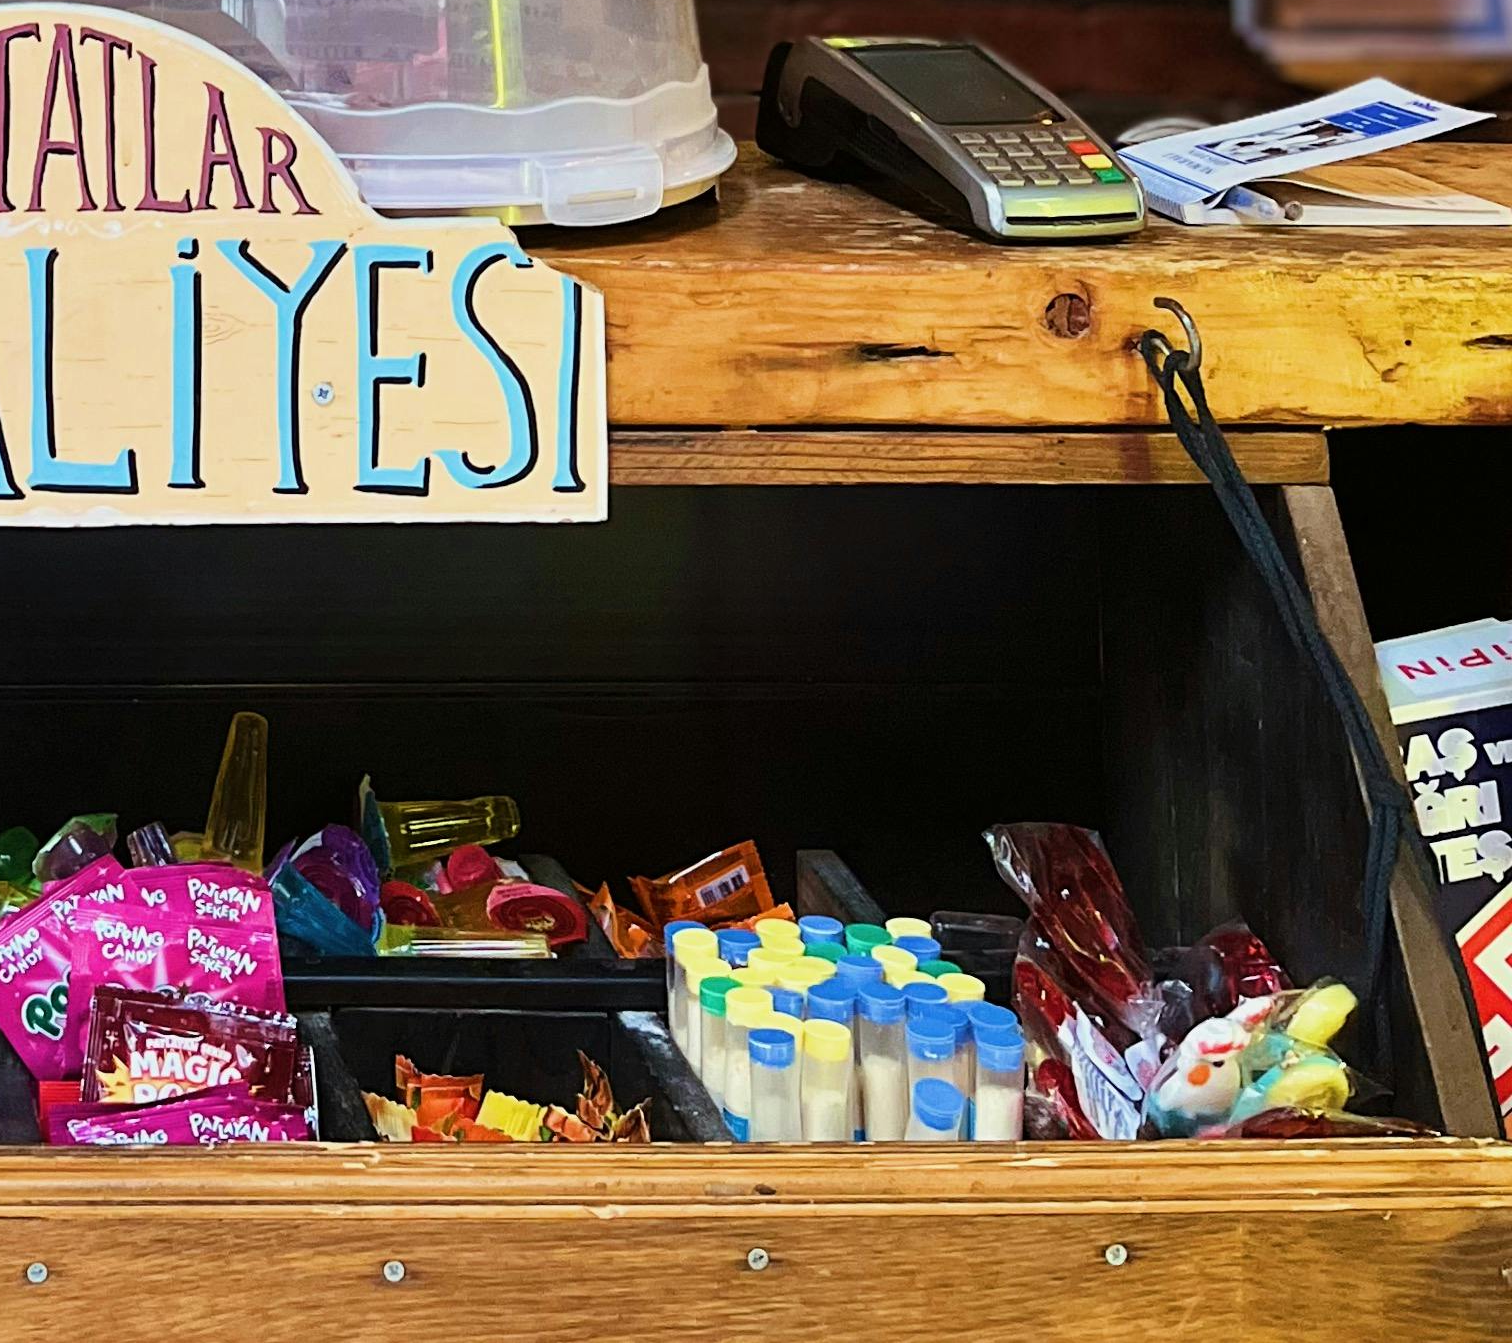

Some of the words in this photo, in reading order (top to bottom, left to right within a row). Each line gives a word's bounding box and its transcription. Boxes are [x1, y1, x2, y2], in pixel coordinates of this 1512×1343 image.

[187, 878, 262, 915] PATLAYAN
[94, 920, 165, 949] POPPING
[101, 942, 157, 965] CANDY
[187, 928, 258, 976] PATLAYAN
